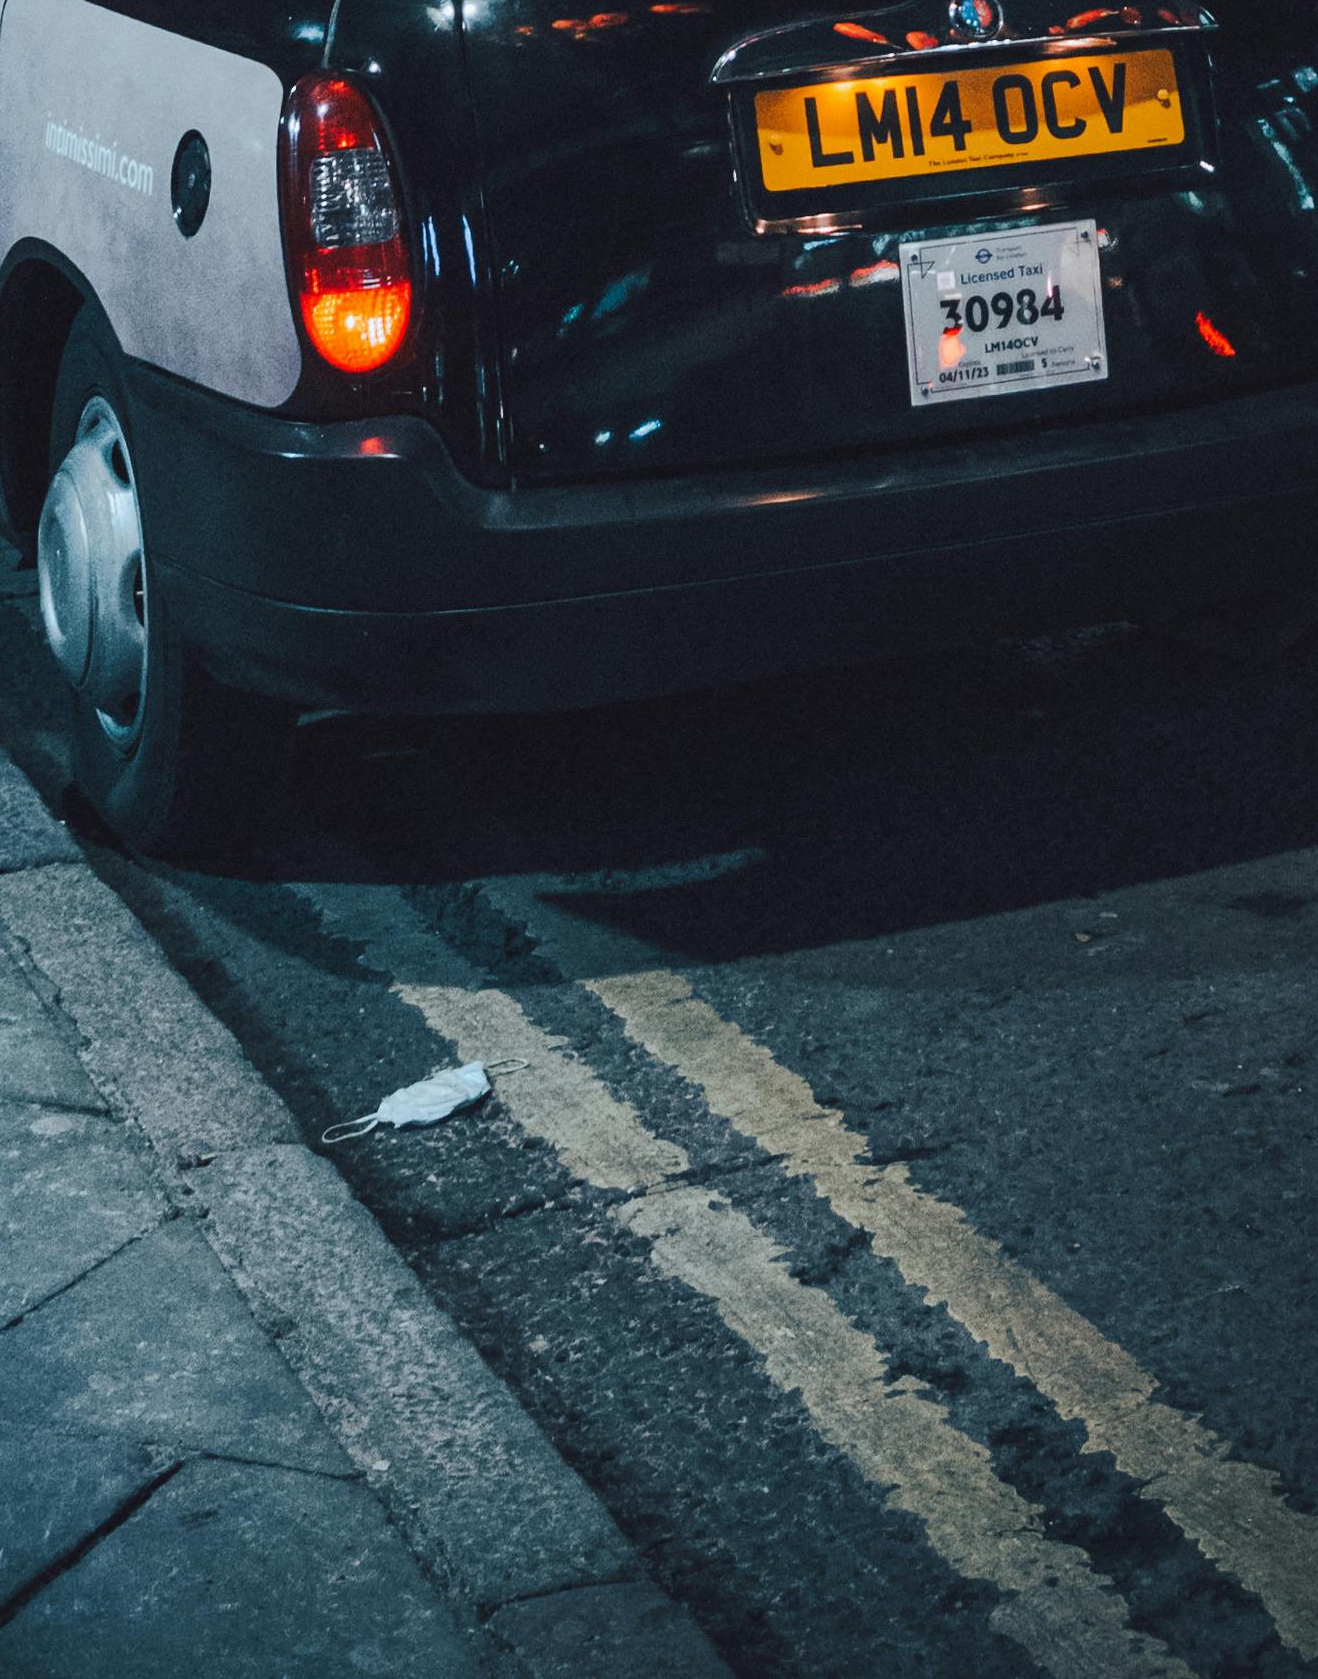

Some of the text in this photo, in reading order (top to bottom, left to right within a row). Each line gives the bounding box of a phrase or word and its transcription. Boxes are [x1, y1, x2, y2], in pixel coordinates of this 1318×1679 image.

[804, 62, 1127, 169] LM14 OCV
[45, 110, 154, 196] intimissimi.com
[928, 159, 941, 168] The
[982, 152, 1015, 163] Company
[960, 262, 1044, 285] Licensed Taxi
[939, 284, 1065, 335] 30984
[984, 335, 1039, 354] LM14OCV
[1041, 357, 1048, 368] 5
[938, 365, 990, 384] 04/11/23
